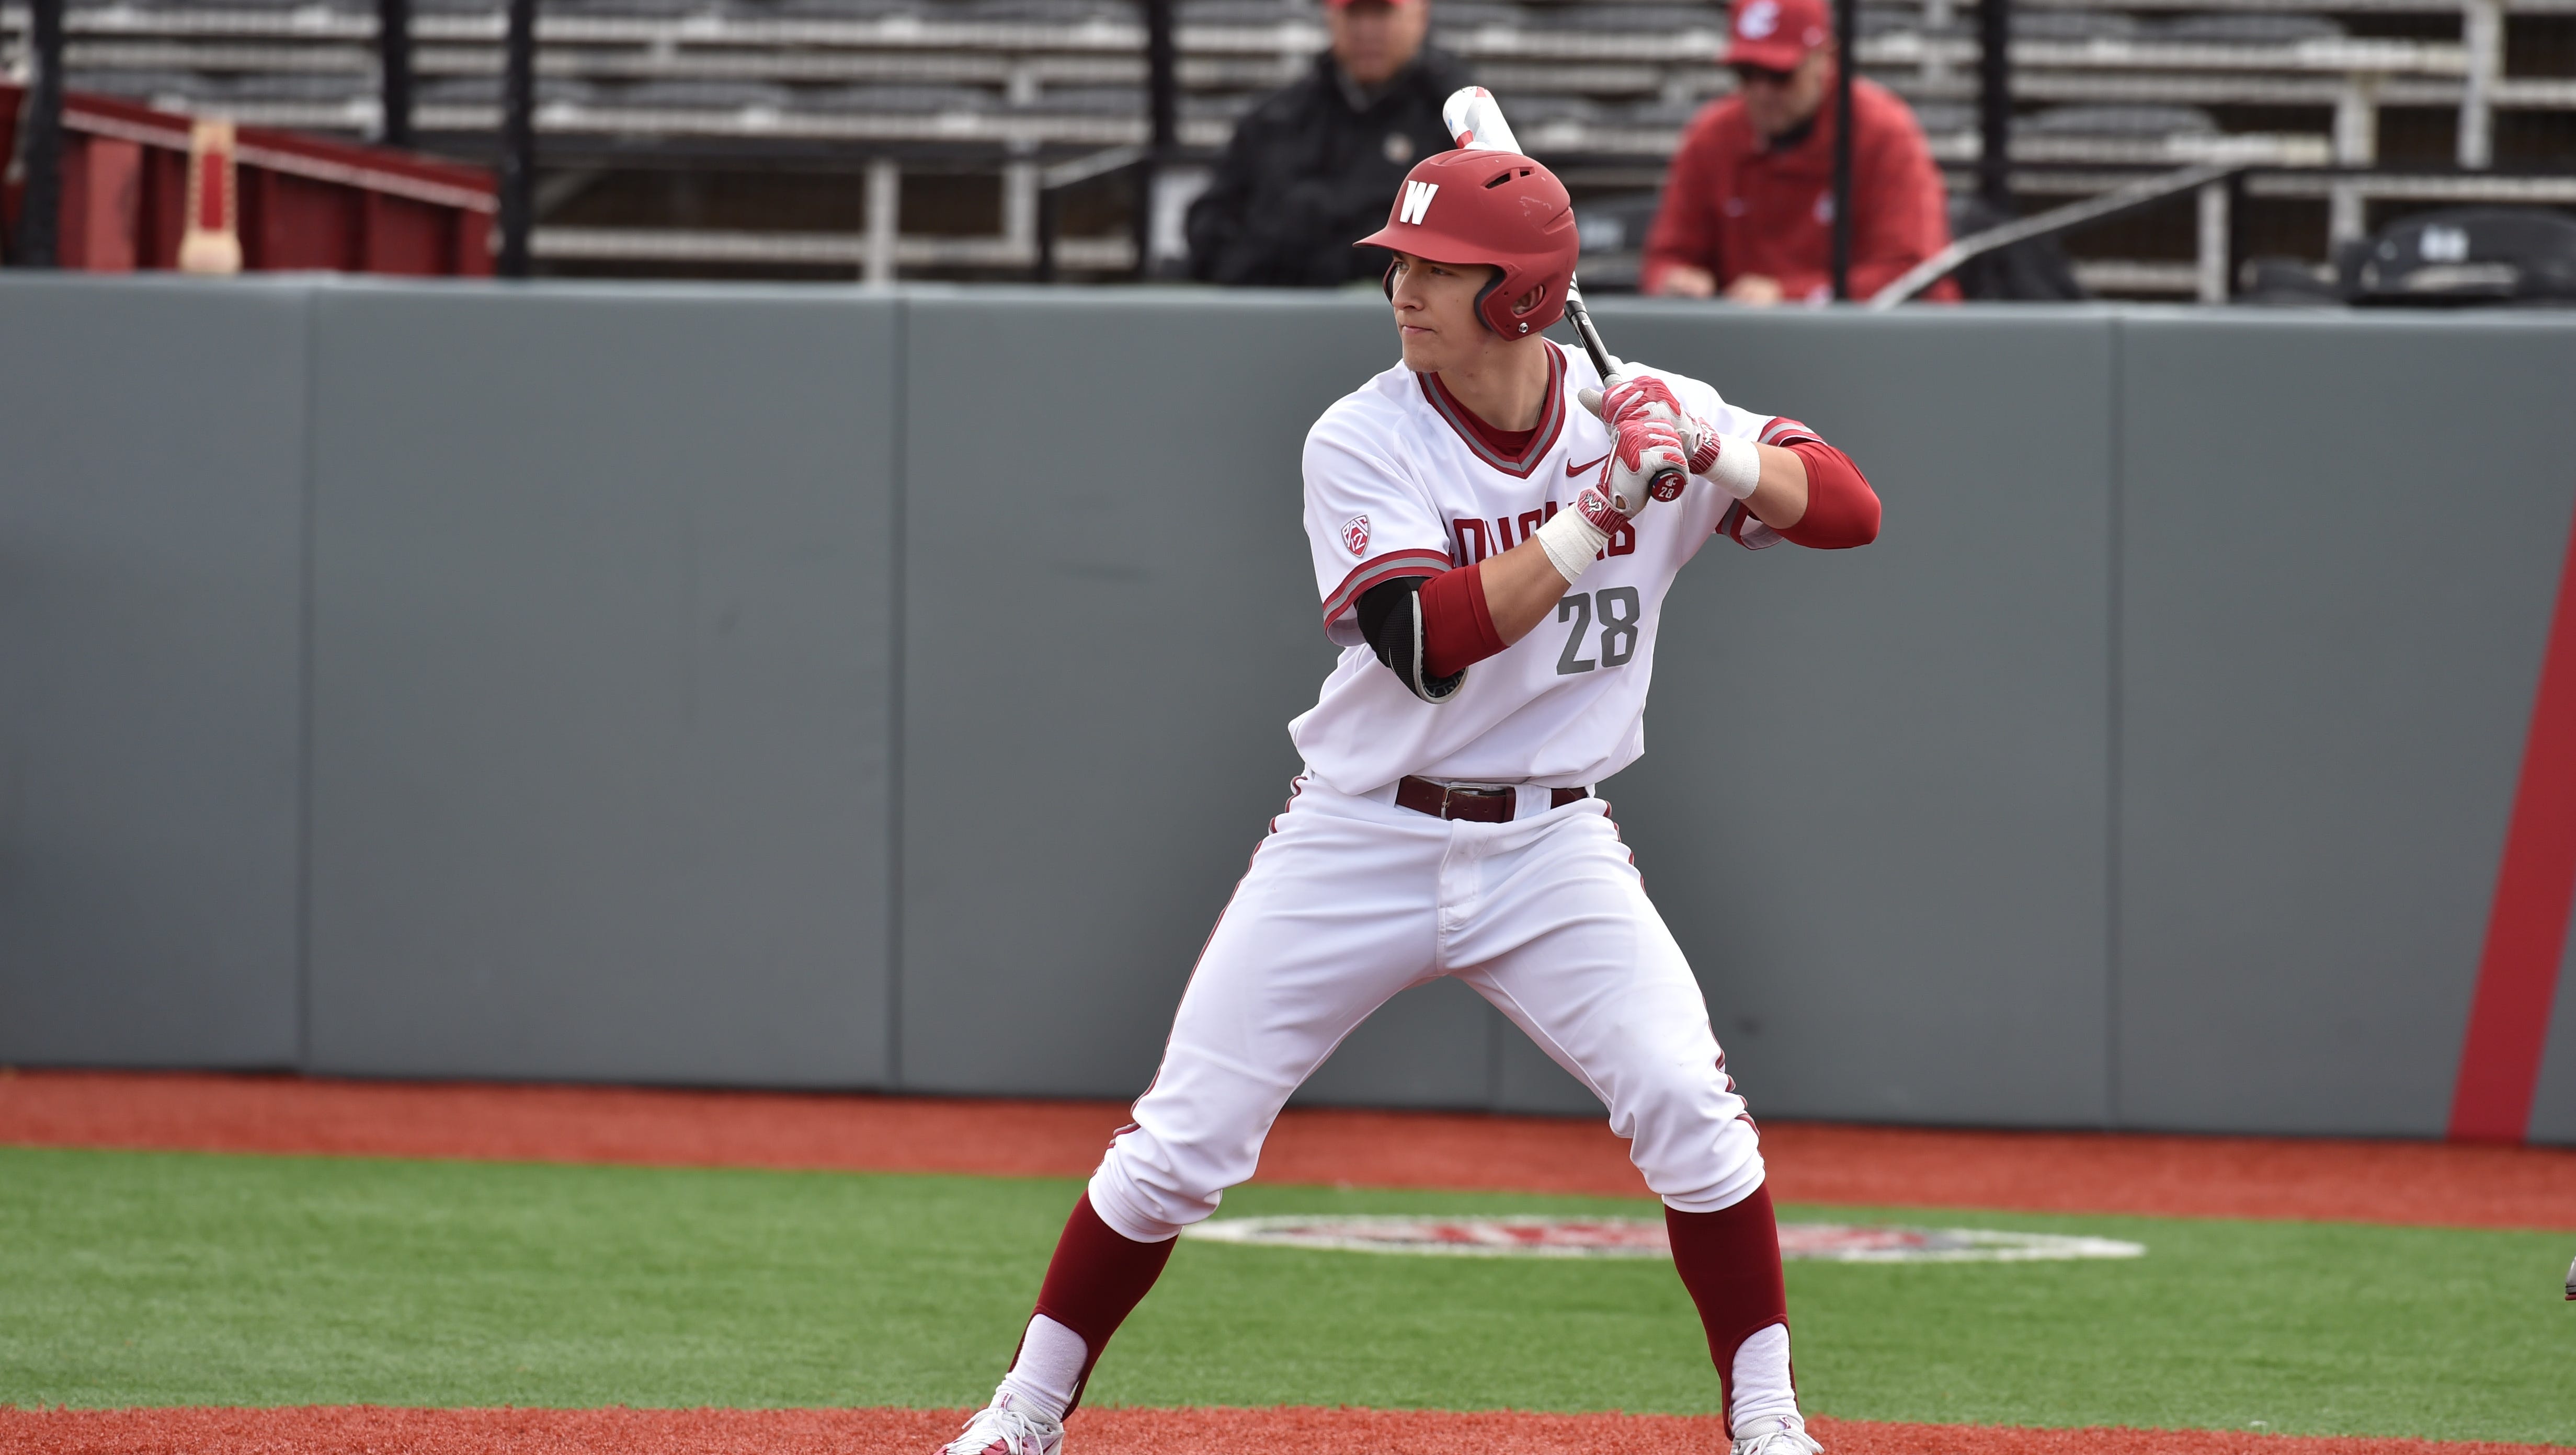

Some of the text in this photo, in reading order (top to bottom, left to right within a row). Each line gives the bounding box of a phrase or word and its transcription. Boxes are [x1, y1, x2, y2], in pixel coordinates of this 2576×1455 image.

[1399, 180, 1439, 225] W
[1658, 486, 1674, 499] 28
[1342, 515, 1368, 548] PAC
[1351, 532, 1365, 552] 12
[1557, 586, 1640, 676] 28
